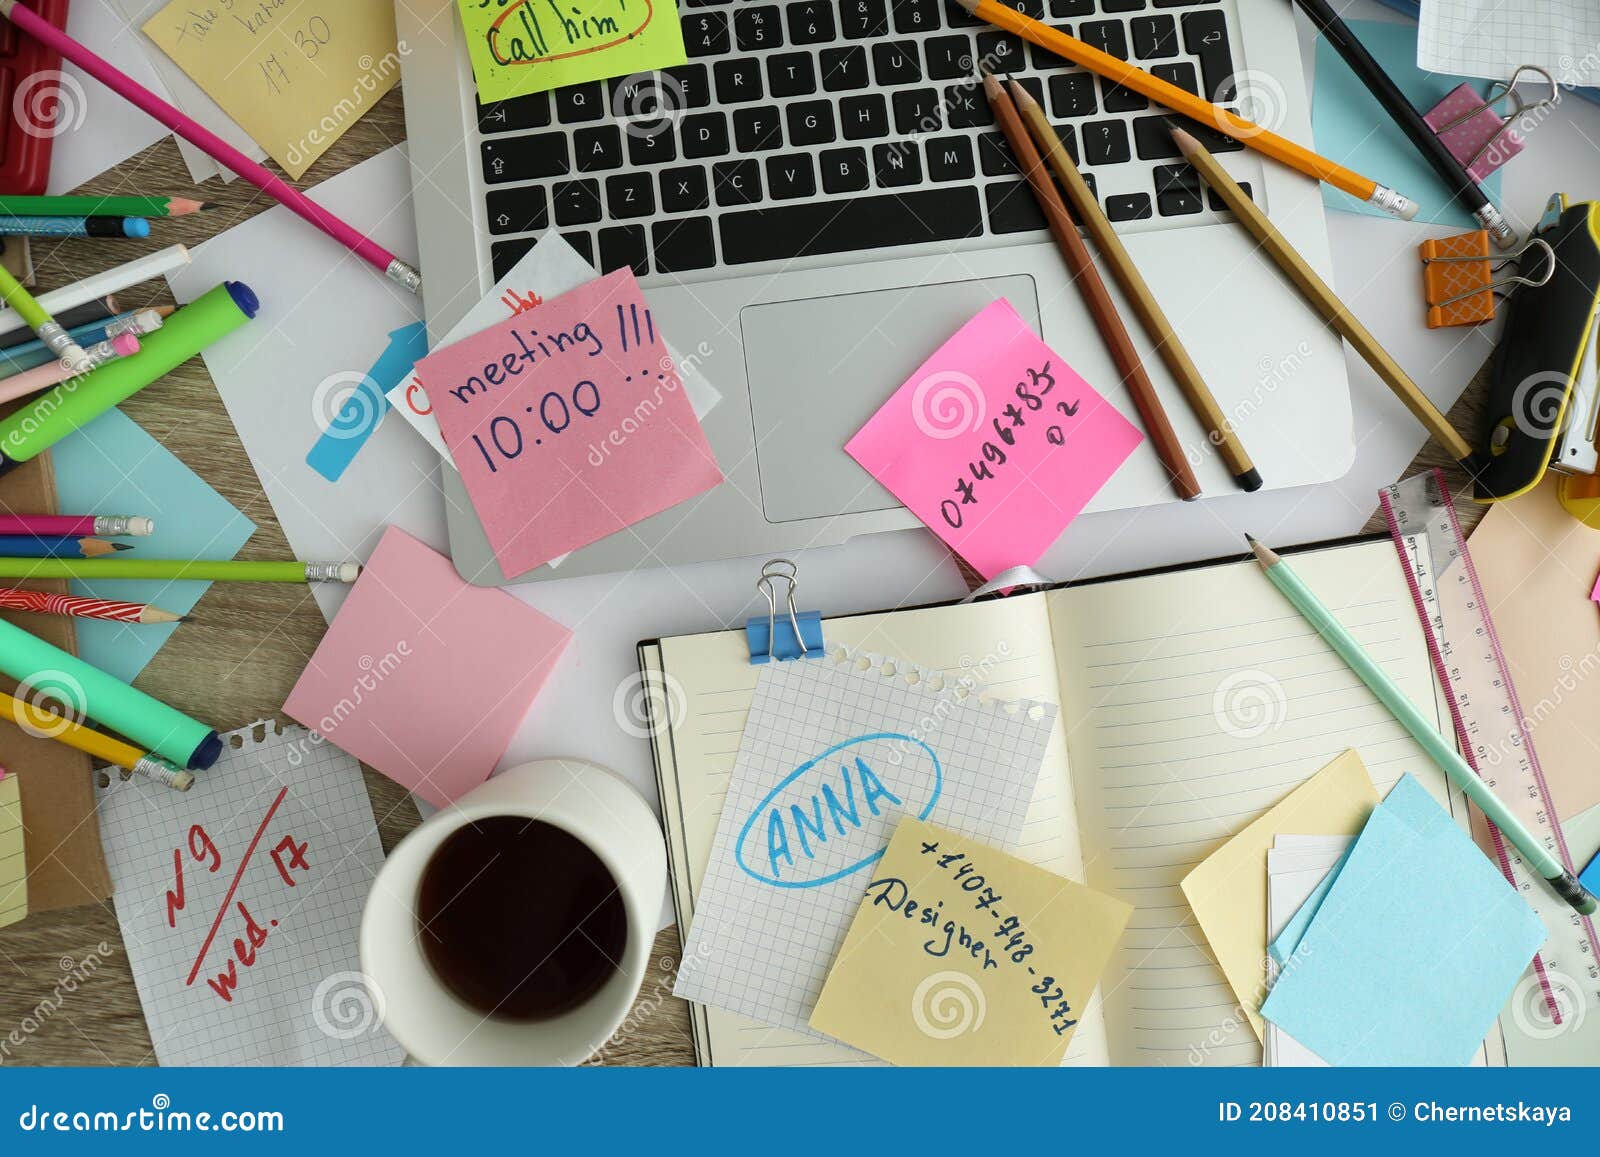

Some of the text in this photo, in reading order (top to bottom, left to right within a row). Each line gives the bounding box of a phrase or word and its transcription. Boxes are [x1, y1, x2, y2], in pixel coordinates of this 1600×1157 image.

[1016, 1, 1026, 14] 0
[860, 17, 869, 29] 7
[913, 11, 921, 23] 8
[486, 0, 549, 66] Call
[755, 29, 764, 41] 5
[808, 23, 816, 35] 6
[702, 35, 711, 47] 4
[839, 60, 848, 73] Y
[891, 55, 903, 68] U
[787, 66, 795, 79] T
[734, 73, 744, 86] R
[573, 93, 586, 106] Q
[964, 98, 976, 111] K
[858, 109, 870, 122] H
[914, 103, 921, 117] J
[753, 121, 761, 134] F
[805, 115, 817, 128] G
[646, 134, 656, 148] S
[699, 128, 710, 141] D
[592, 141, 604, 154] A
[944, 151, 958, 165] M
[785, 169, 795, 182] V
[839, 162, 849, 176] B
[678, 181, 689, 195] X
[732, 175, 743, 188] C
[624, 188, 635, 202] Z
[449, 321, 603, 403] meeting
[472, 380, 601, 473] 10:00
[767, 756, 902, 878] ANNA
[270, 835, 310, 887] 17
[865, 878, 998, 970] Designer
